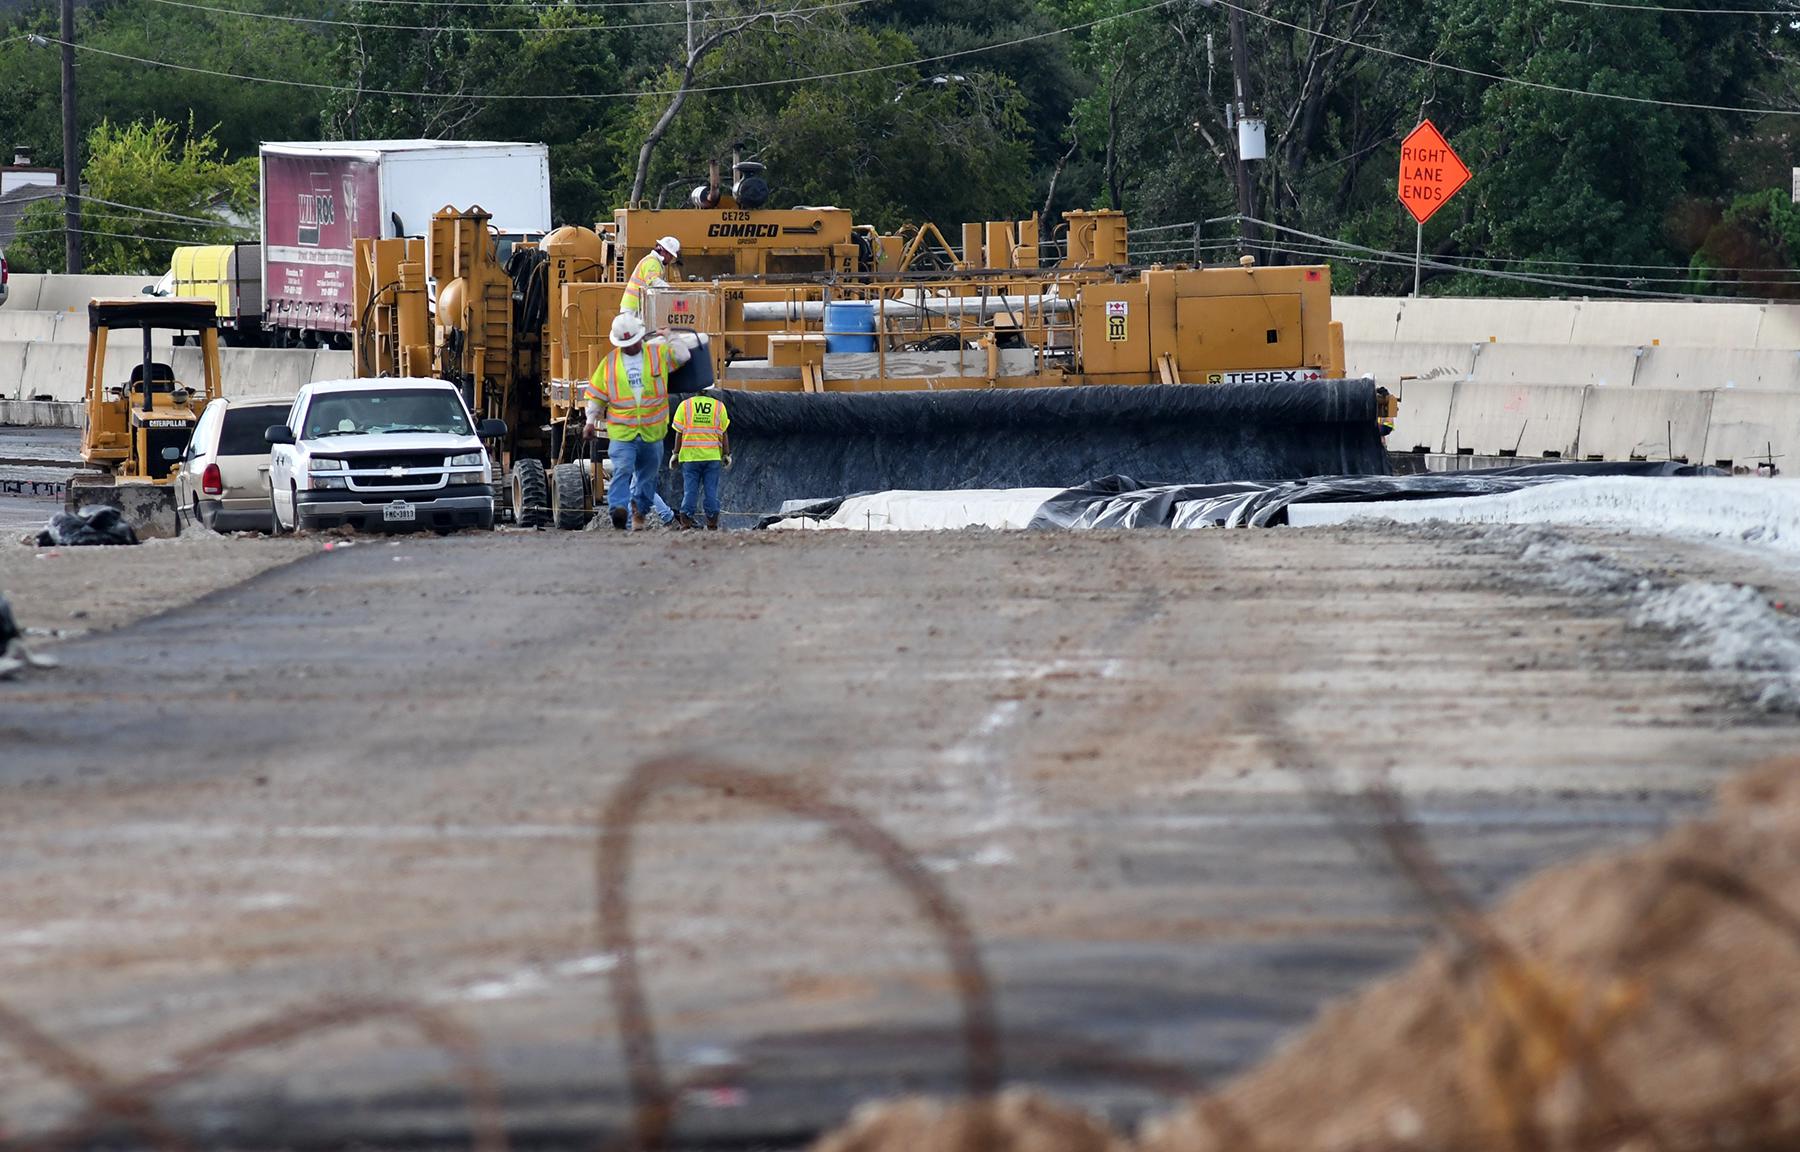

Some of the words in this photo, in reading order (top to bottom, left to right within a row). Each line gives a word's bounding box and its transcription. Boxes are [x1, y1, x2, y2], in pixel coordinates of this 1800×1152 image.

[1402, 147, 1447, 163] RIGHT
[1404, 166, 1443, 182] LANE
[1403, 185, 1443, 200] ENDS
[721, 211, 750, 221] CE725
[707, 223, 779, 237] GOMACO
[667, 314, 695, 324] CE172
[1226, 371, 1297, 384] TEREX
[694, 402, 712, 414] WB
[149, 419, 187, 427] CATERPILLAR
